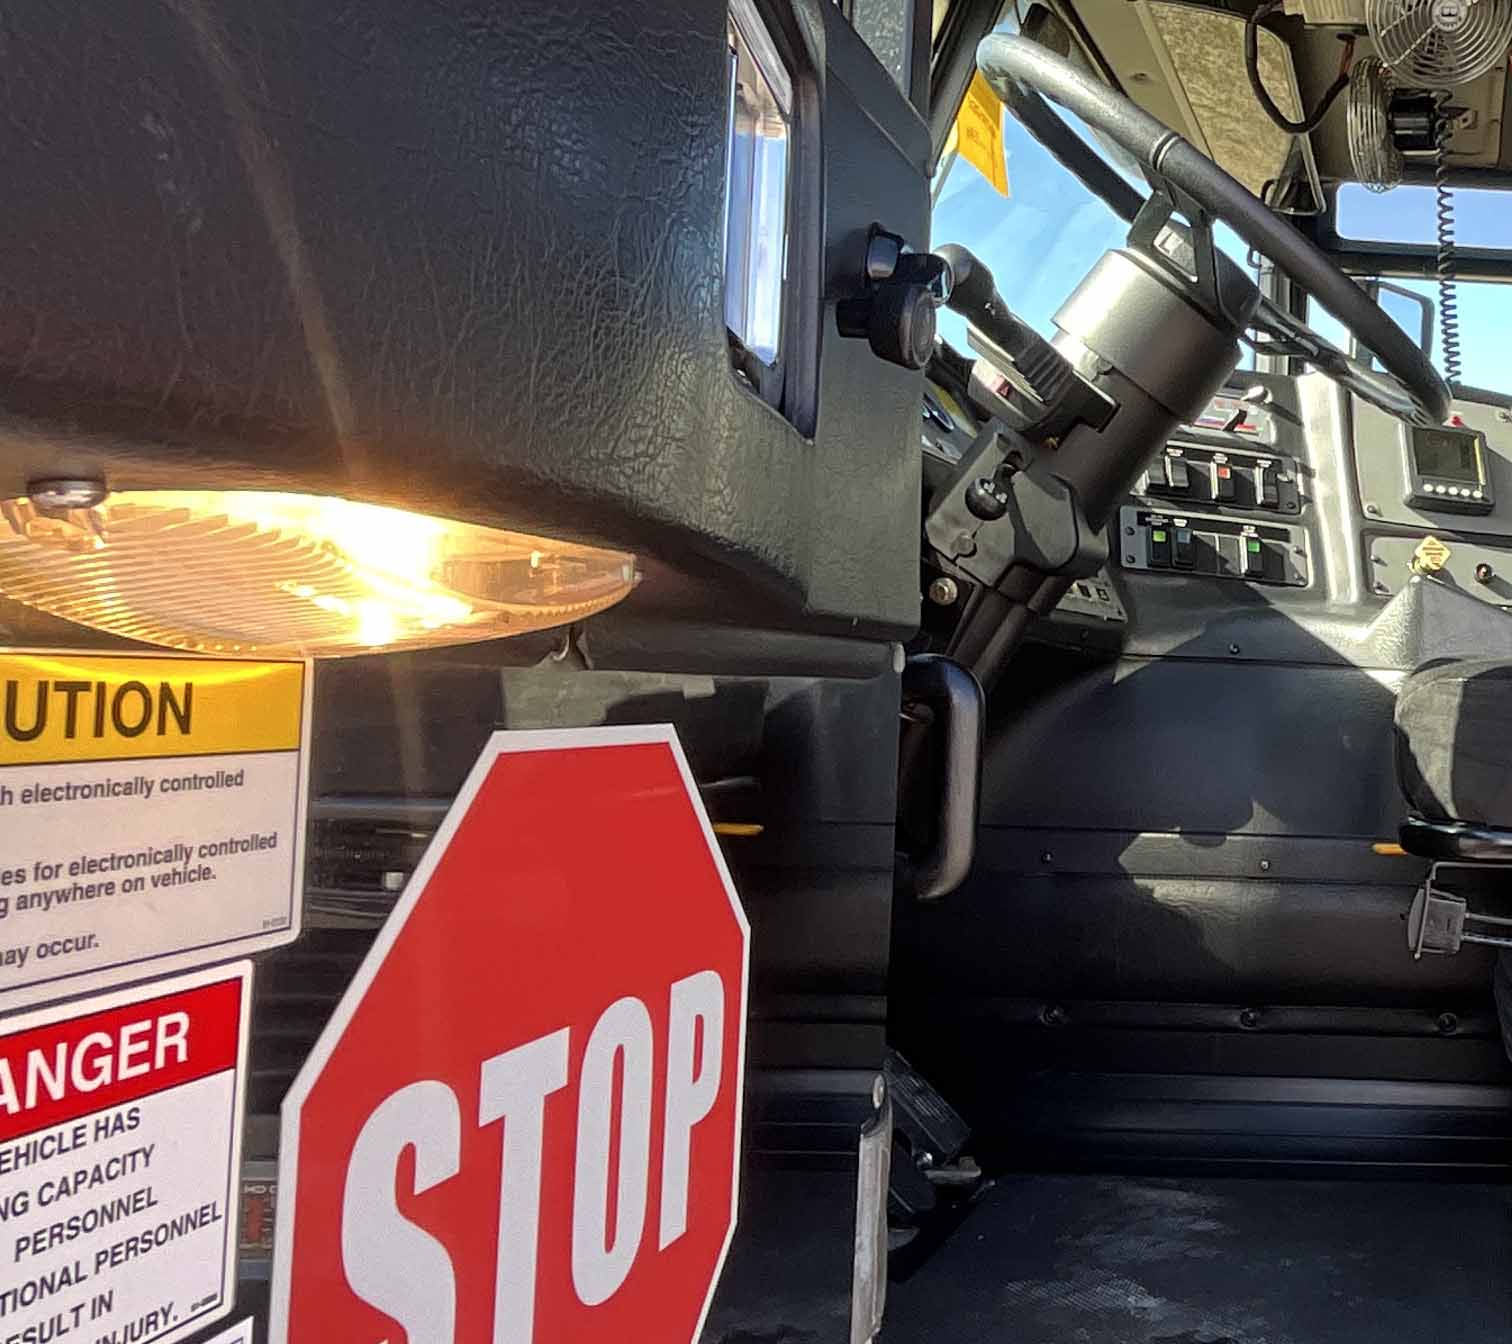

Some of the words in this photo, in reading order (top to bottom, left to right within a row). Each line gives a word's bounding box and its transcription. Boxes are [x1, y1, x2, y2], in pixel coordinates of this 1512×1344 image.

[4, 679, 193, 742] UTION
[21, 777, 154, 805] electronically
[160, 769, 244, 793] controlled
[34, 862, 63, 882] for
[68, 843, 194, 877] electronically
[199, 832, 278, 858] controlled
[16, 879, 116, 912] anywhere
[121, 875, 145, 894] on
[151, 863, 217, 889] vehicle.
[36, 933, 100, 959] occur.
[94, 1106, 141, 1143] HAS
[37, 1143, 156, 1207] CAPACITY
[14, 1186, 159, 1263] PERSONNEL
[94, 1200, 223, 1275] PERSONNEL
[90, 1289, 114, 1321] IN
